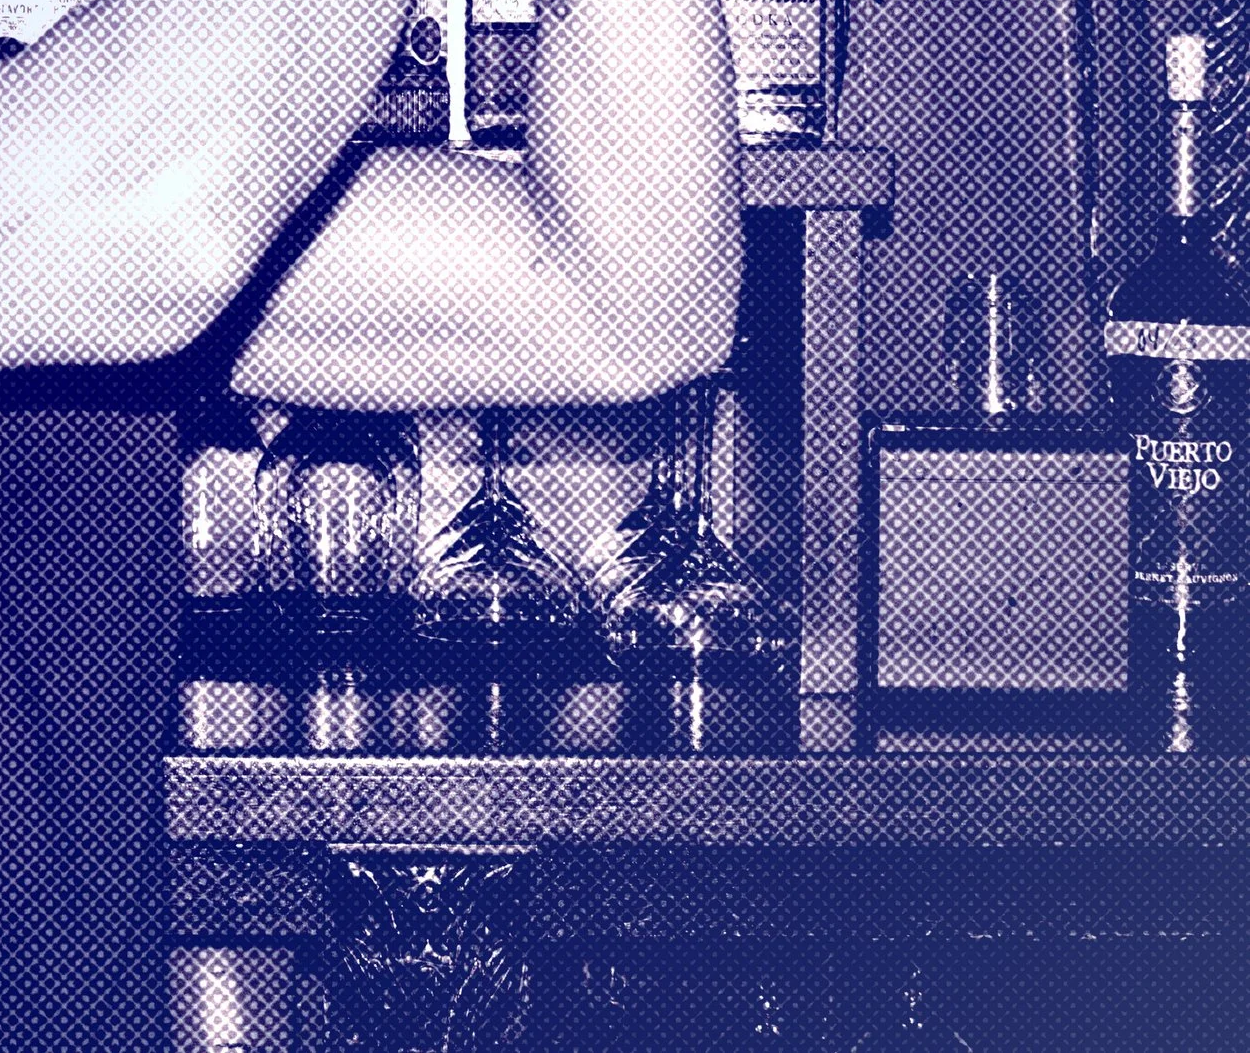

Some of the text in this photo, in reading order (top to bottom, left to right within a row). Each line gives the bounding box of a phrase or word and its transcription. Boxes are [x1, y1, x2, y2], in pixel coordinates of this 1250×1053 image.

[1134, 434, 1233, 463] PUERTO
[1146, 461, 1221, 495] VIEJO
[1178, 572, 1239, 585] AUVIGNON
